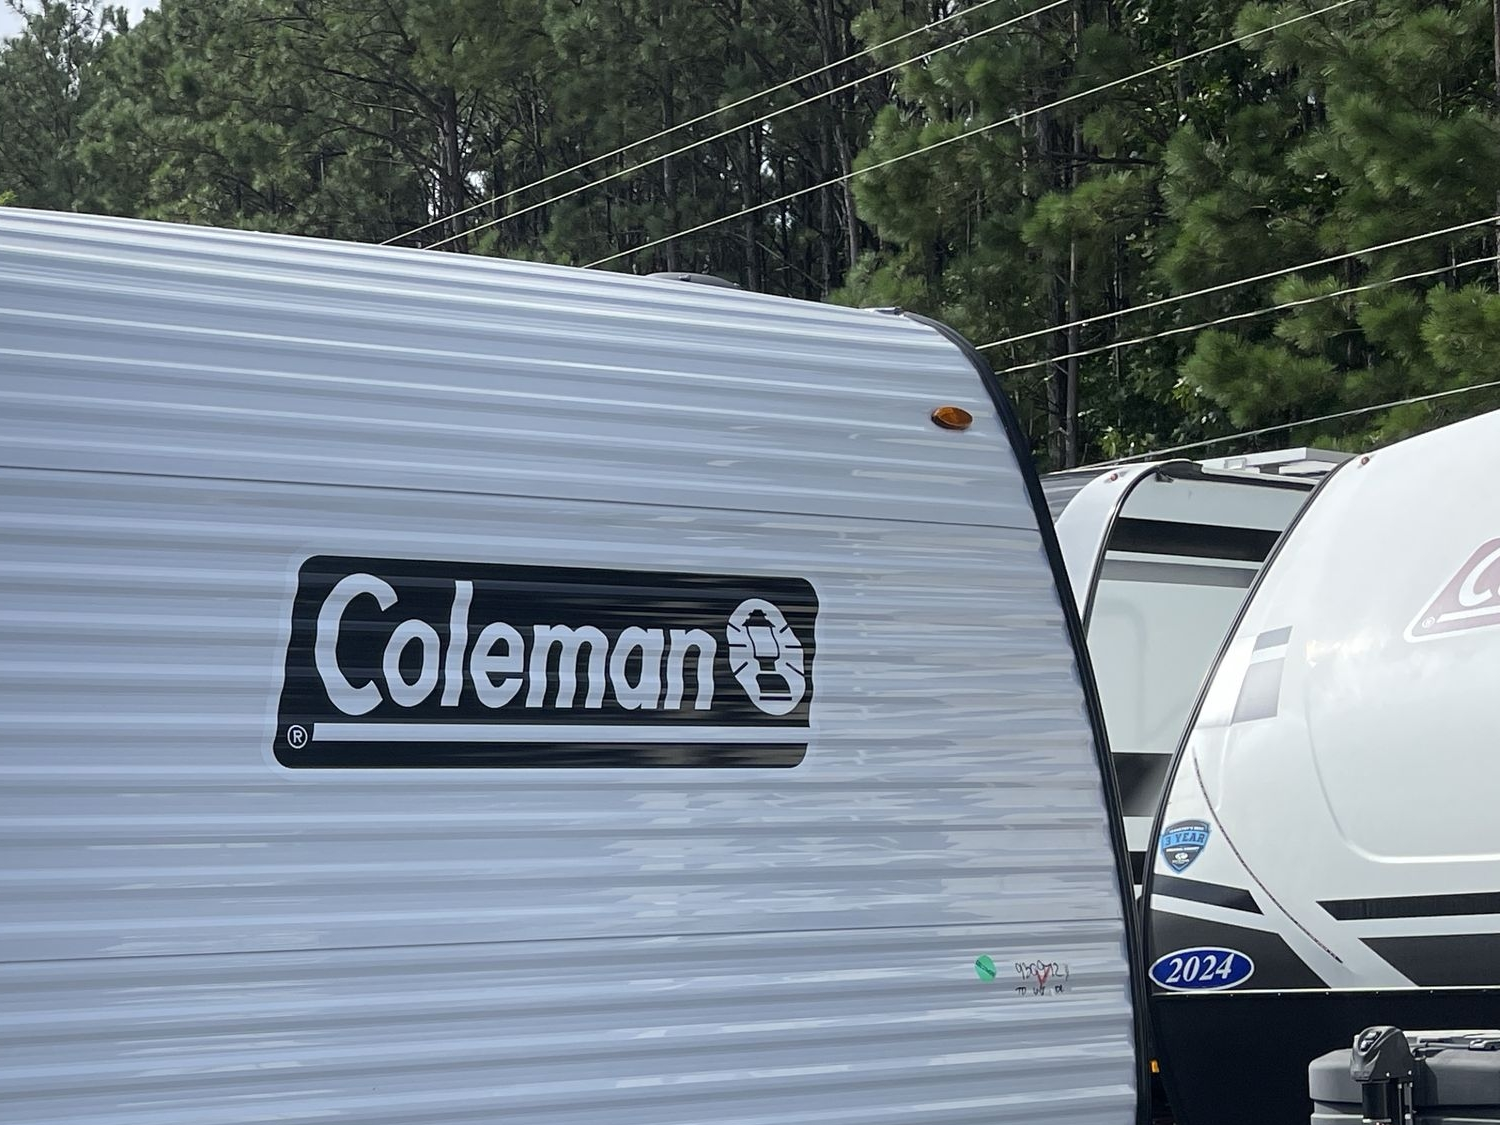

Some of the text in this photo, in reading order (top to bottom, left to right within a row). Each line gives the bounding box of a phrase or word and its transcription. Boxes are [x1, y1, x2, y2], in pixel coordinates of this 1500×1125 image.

[314, 572, 718, 716] Coleman
[1165, 832, 1206, 846] 3 YEAR
[1165, 953, 1235, 983] 2024
